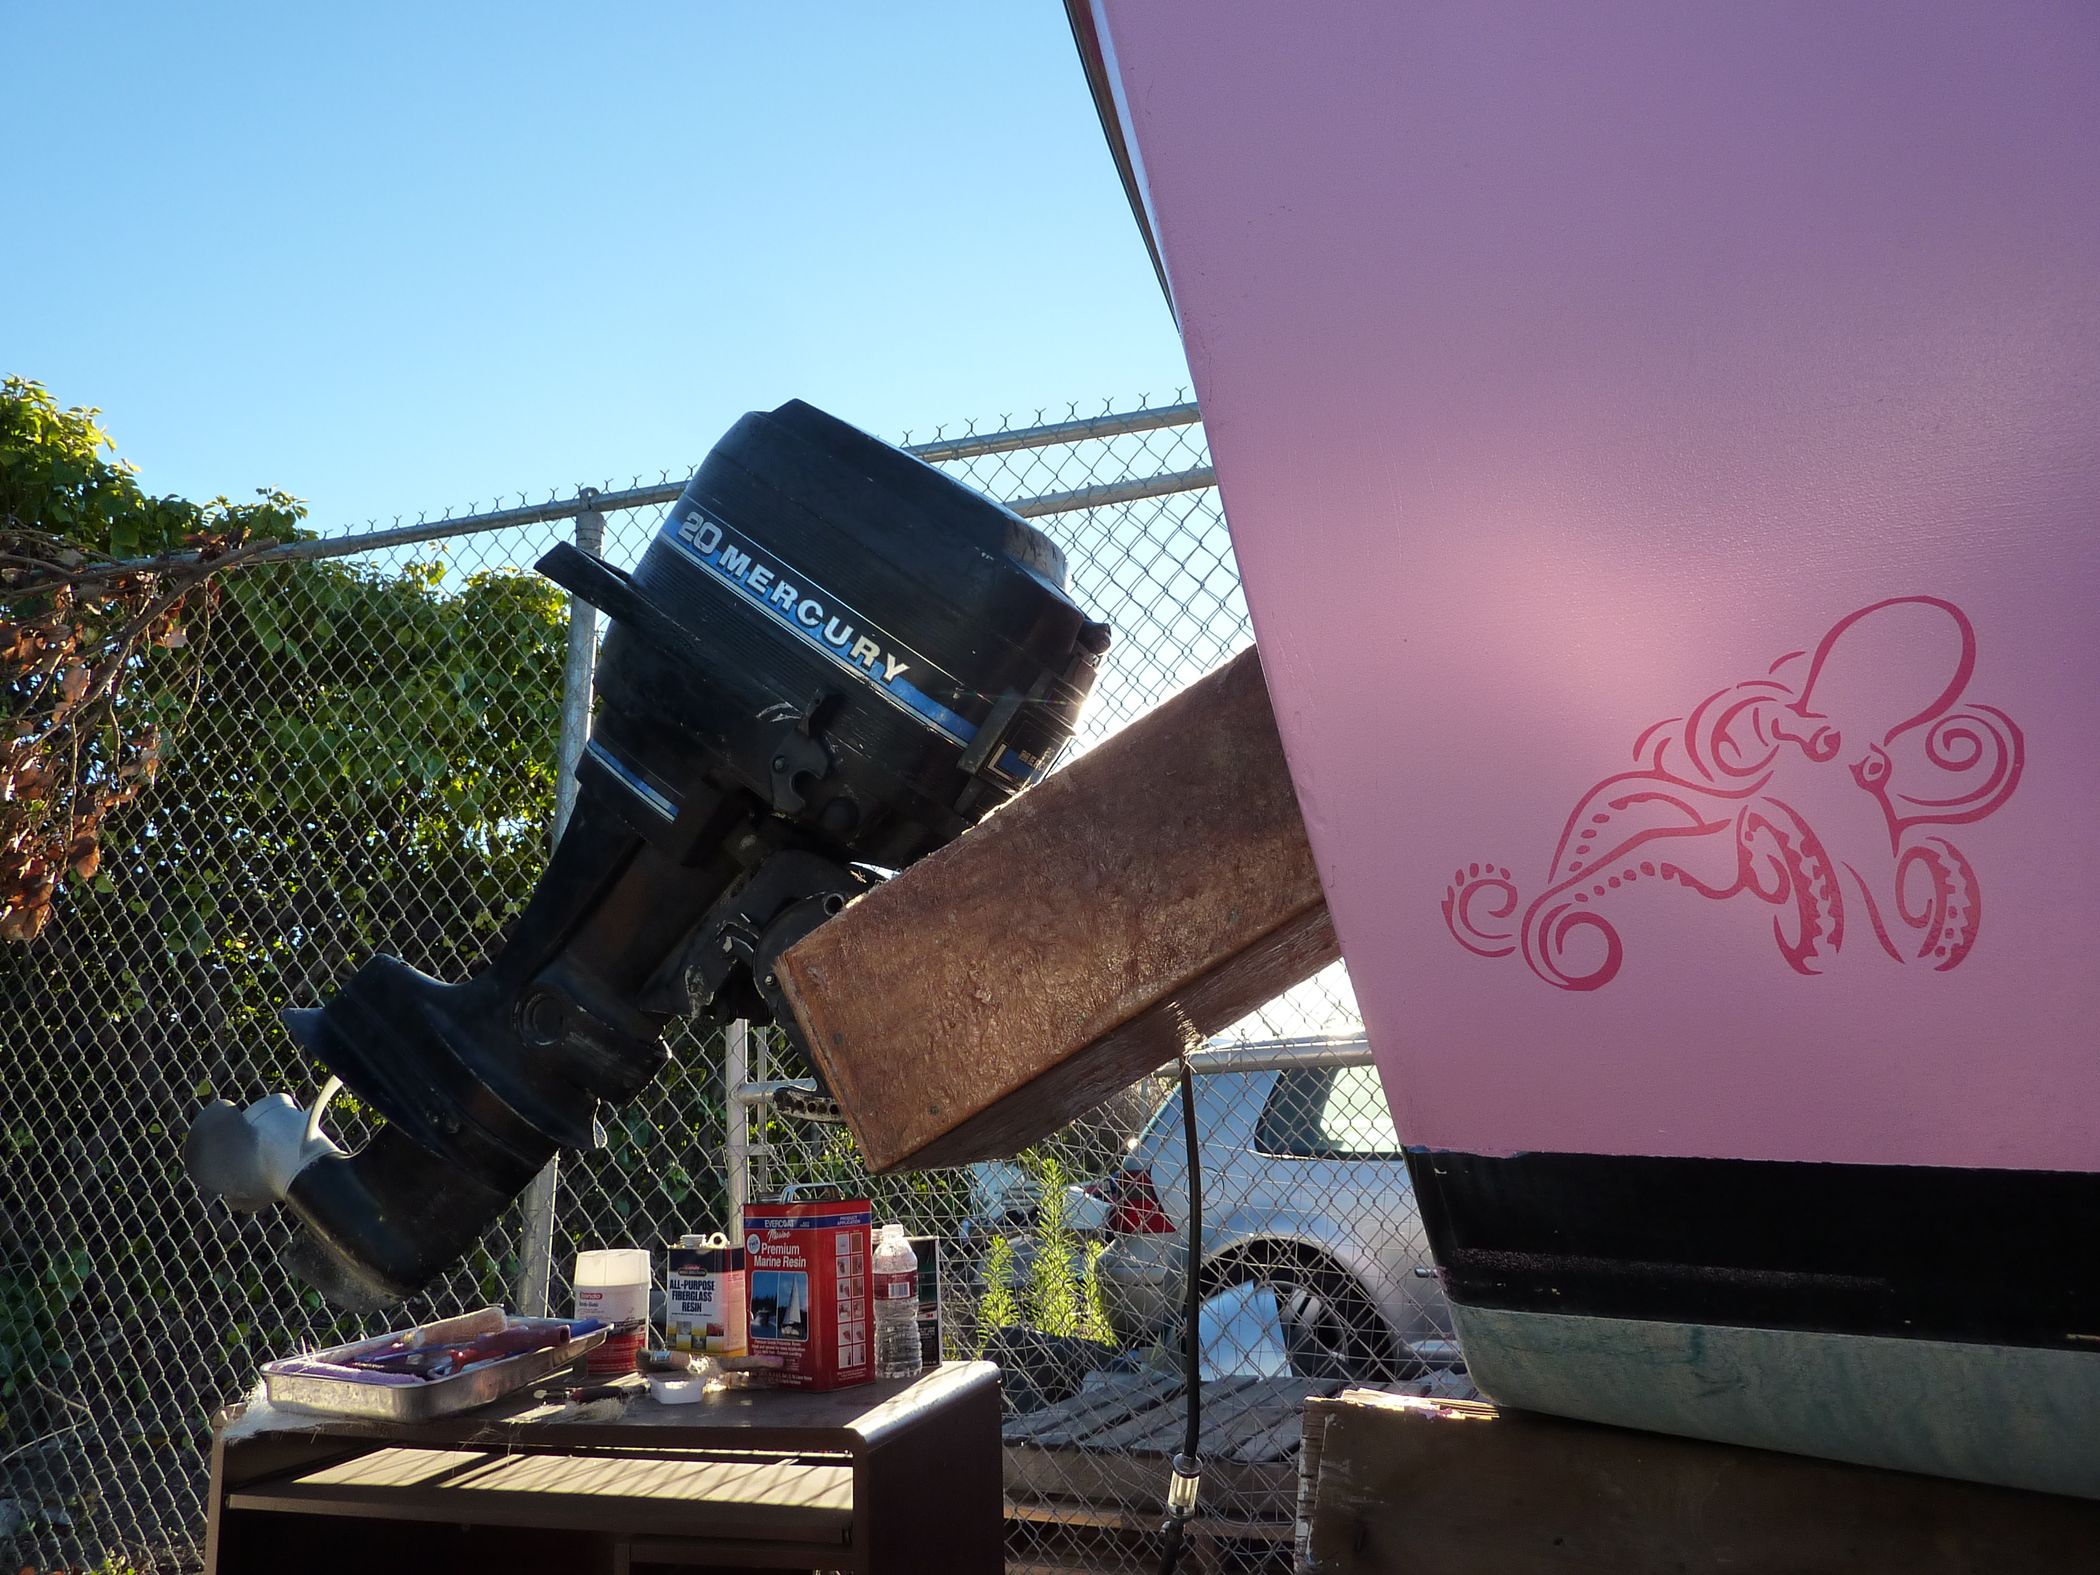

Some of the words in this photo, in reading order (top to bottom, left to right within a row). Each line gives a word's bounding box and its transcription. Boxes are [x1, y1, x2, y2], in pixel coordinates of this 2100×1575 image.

[678, 511, 723, 554] 20
[719, 544, 911, 682] MERCURY
[764, 1219, 795, 1228] EVERCOAT
[761, 1242, 800, 1255] Premium
[754, 1256, 781, 1267] Marine
[782, 1256, 807, 1268] Resin
[669, 1280, 715, 1291] ALL-PURPOSE
[671, 1291, 713, 1302] FIBERGLASS
[681, 1302, 702, 1312] RESIN
